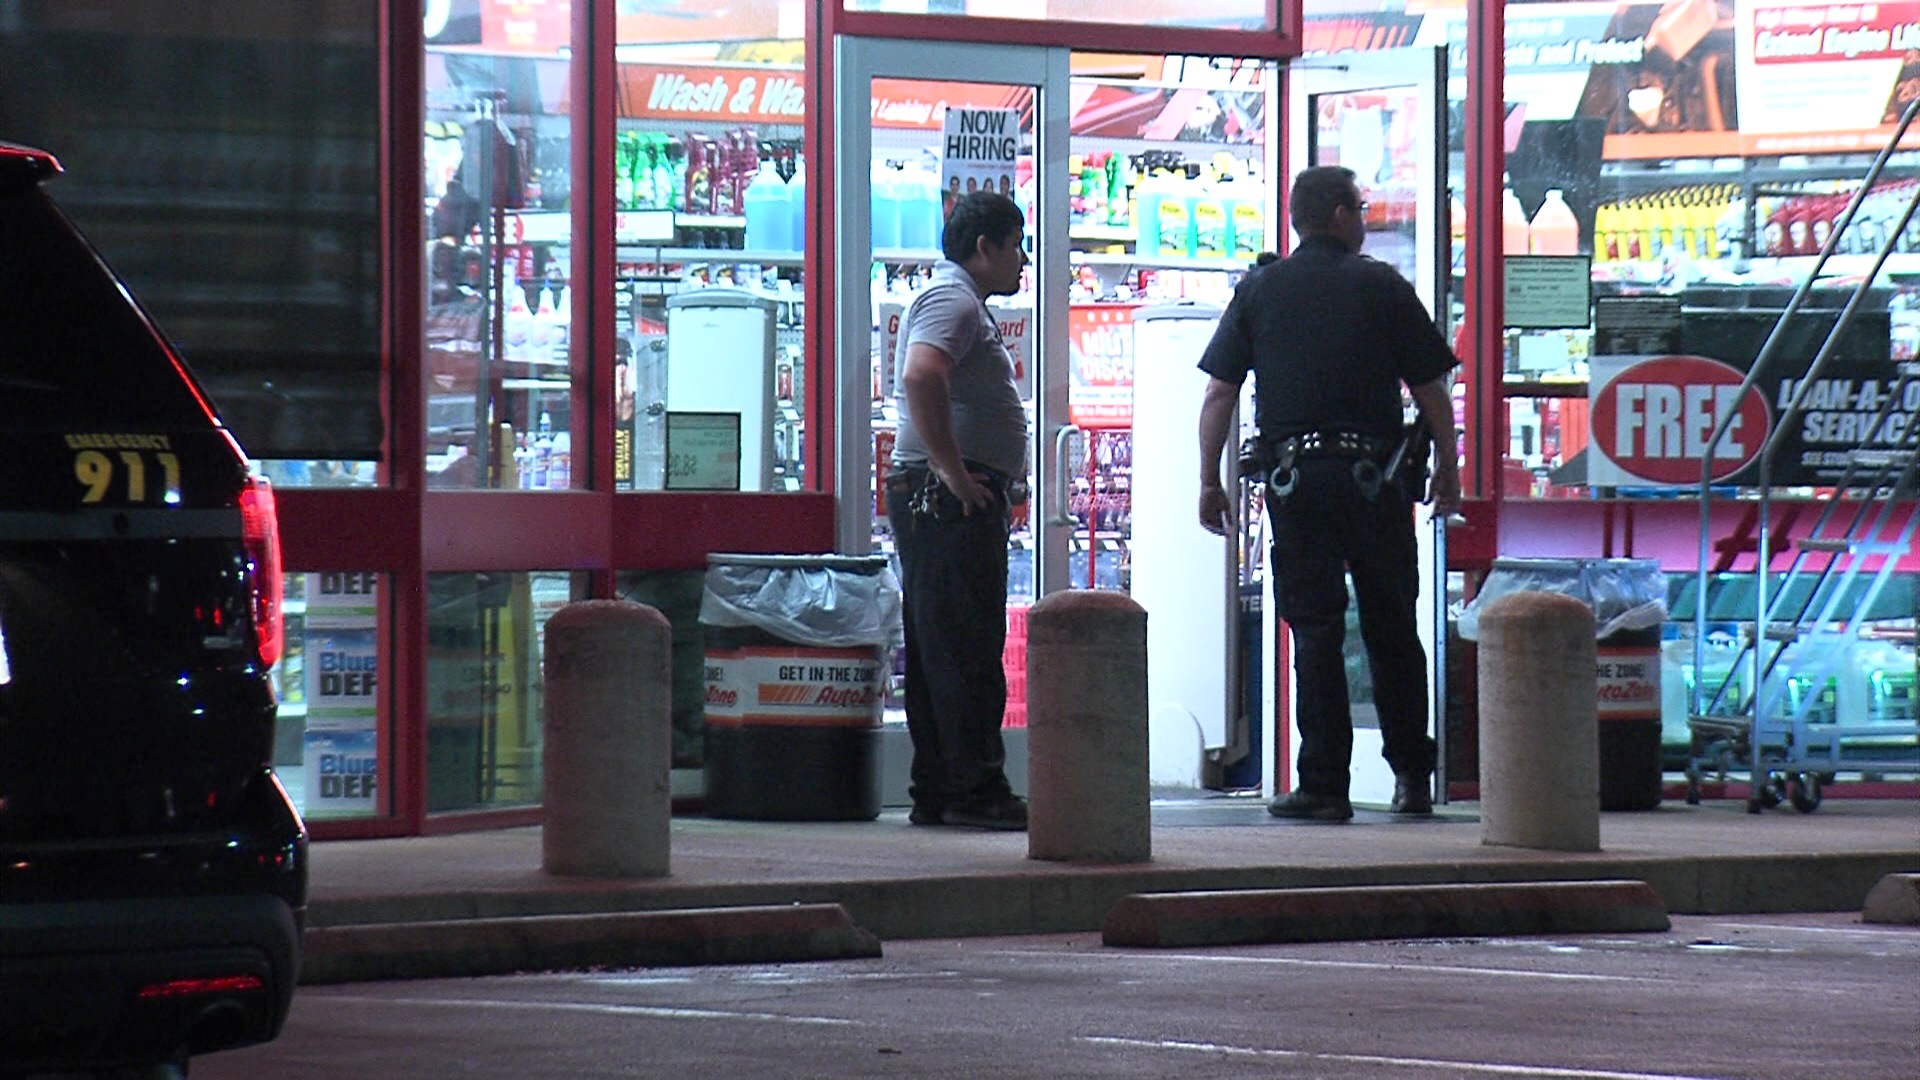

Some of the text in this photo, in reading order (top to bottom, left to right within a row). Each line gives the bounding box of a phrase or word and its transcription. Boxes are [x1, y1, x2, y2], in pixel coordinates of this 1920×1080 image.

[1536, 38, 1575, 66] and
[1574, 36, 1643, 64] Protect
[1755, 28, 1822, 58] Extend
[1822, 26, 1890, 60] Engine
[648, 73, 805, 116] Wash & Wa
[960, 110, 1006, 134] NOW
[946, 135, 1016, 161] HIRING
[999, 319, 1025, 338] ard
[1615, 384, 1744, 458] FREE
[75, 450, 180, 503] 911
[319, 652, 377, 671] Blue
[779, 666, 804, 681] GET
[809, 666, 824, 681] IN
[828, 666, 851, 681] THE
[319, 673, 377, 696] DEF
[319, 752, 377, 774] Blue
[319, 775, 377, 798] DEF
